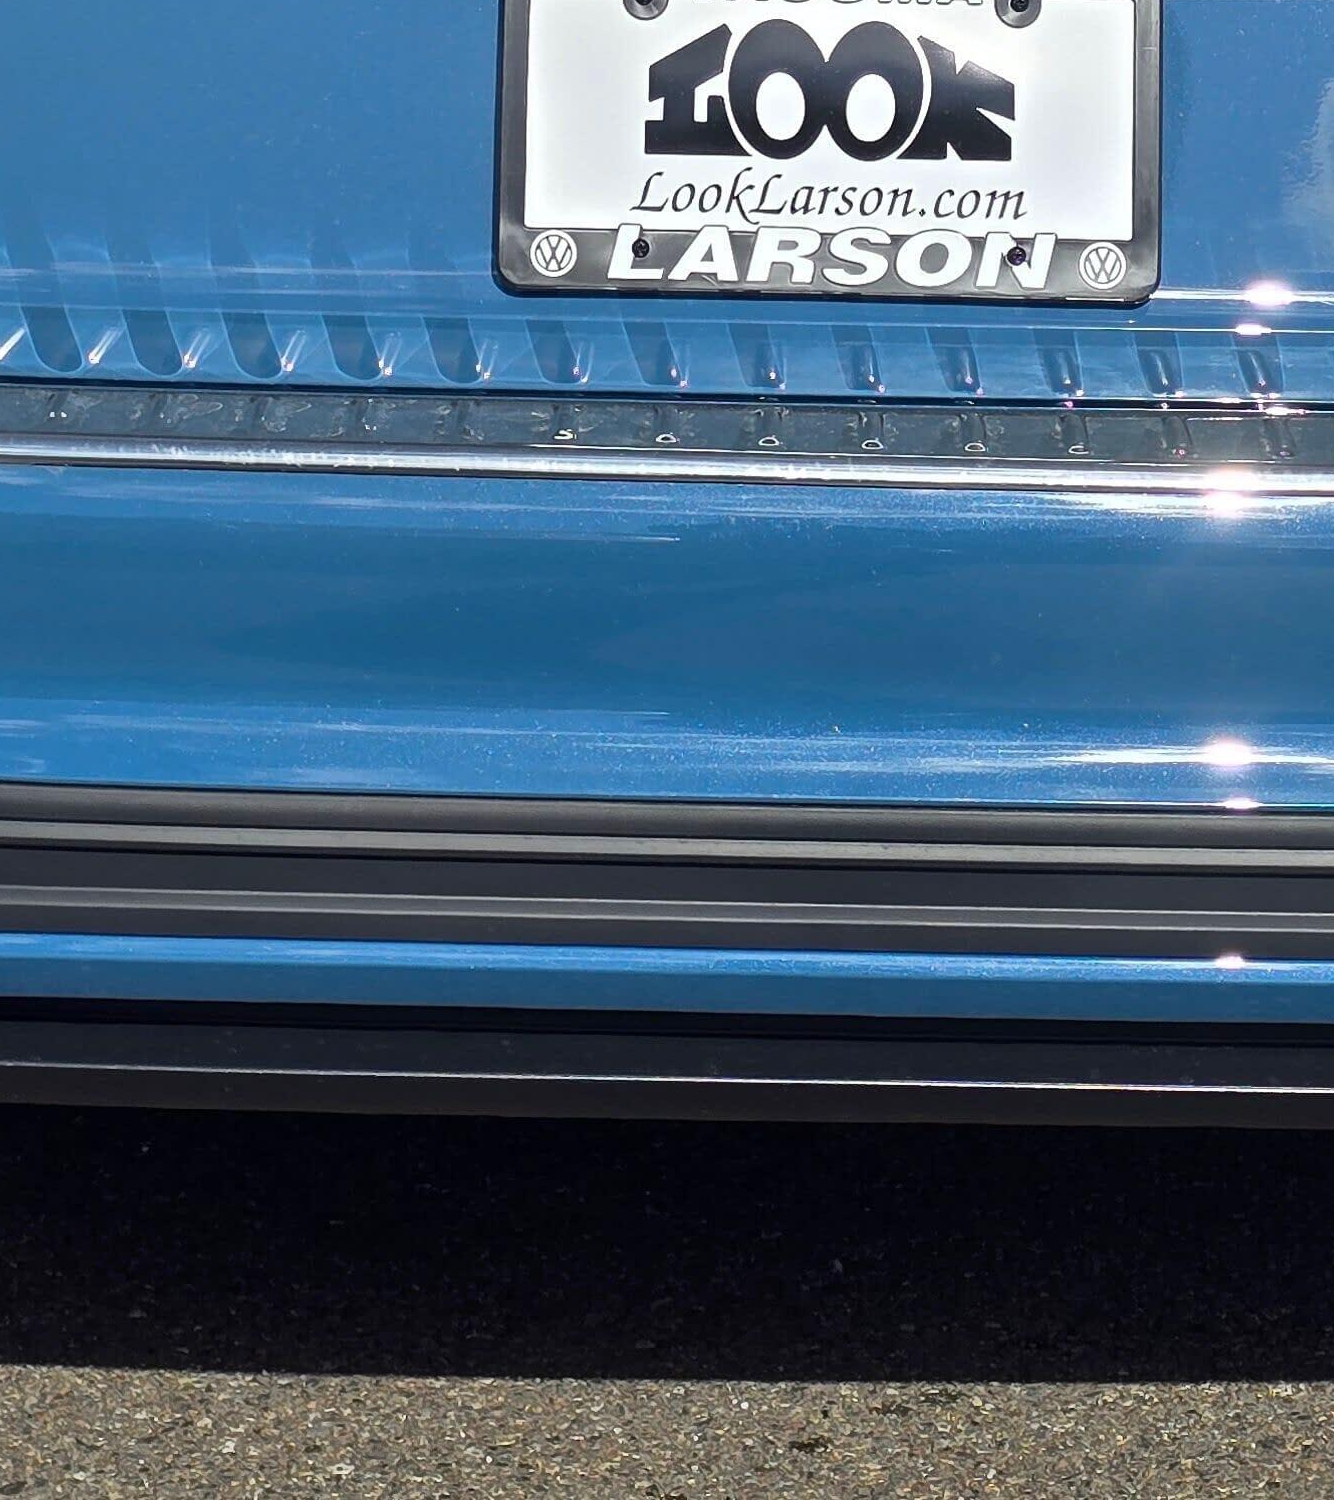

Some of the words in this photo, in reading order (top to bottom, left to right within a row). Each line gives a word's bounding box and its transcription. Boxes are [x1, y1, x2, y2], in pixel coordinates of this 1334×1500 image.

[644, 18, 1016, 162] LOOK
[629, 167, 1028, 225] LookLarson.com
[606, 224, 1058, 289] LARSON
